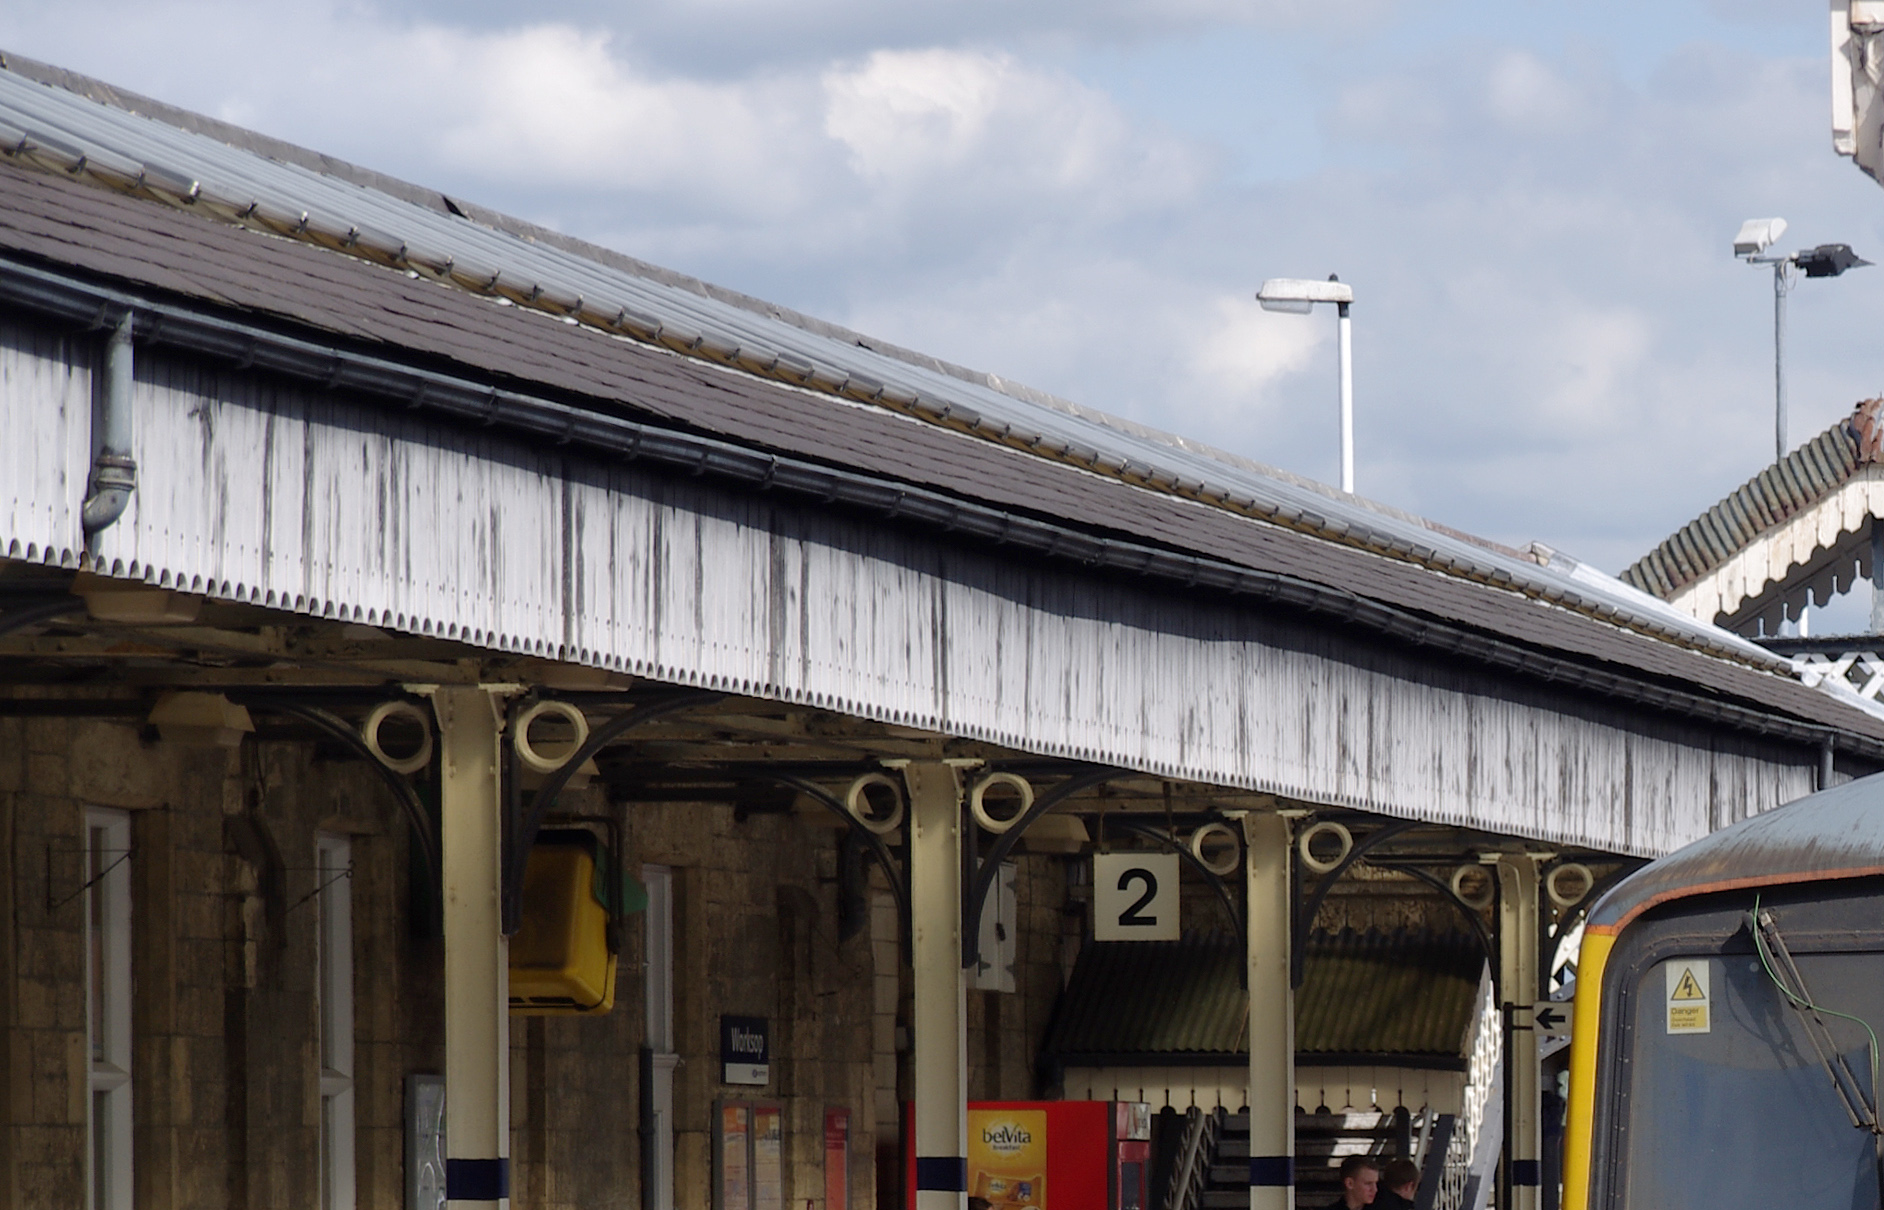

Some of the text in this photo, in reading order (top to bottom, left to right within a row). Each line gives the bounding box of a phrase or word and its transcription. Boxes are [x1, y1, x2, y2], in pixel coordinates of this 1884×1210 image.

[1117, 868, 1158, 926] 2
[731, 1026, 764, 1060] Worksop
[983, 1124, 1031, 1144] belVita
